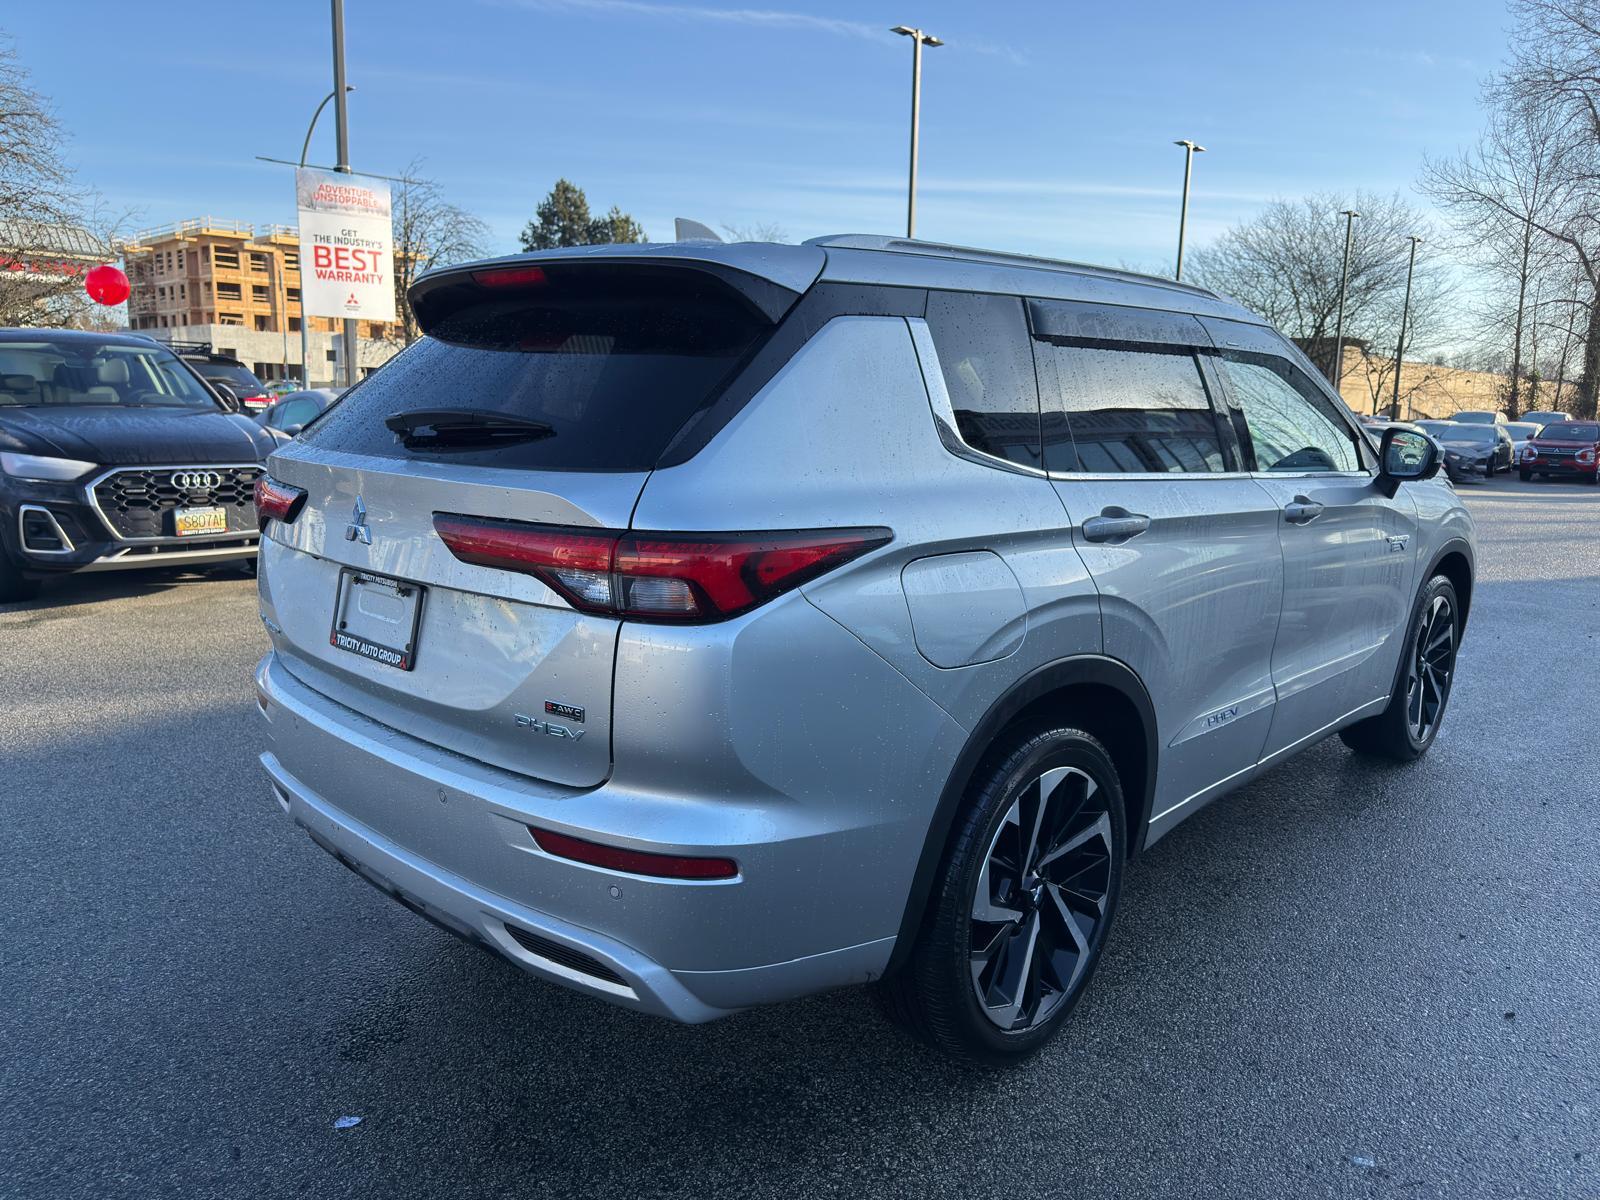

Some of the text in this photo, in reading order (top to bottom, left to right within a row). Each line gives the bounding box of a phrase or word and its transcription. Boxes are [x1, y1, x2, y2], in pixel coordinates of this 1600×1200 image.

[318, 184, 375, 199] ADVENTURE
[341, 229, 358, 238] GET
[313, 234, 383, 250] THE INDUSTRY'S
[313, 245, 384, 273] BEST
[315, 269, 384, 285] WARRANTY
[337, 634, 401, 664] TRICITY AUTO GROUP
[546, 703, 582, 717] S-AWC
[1207, 704, 1239, 727] PHEV
